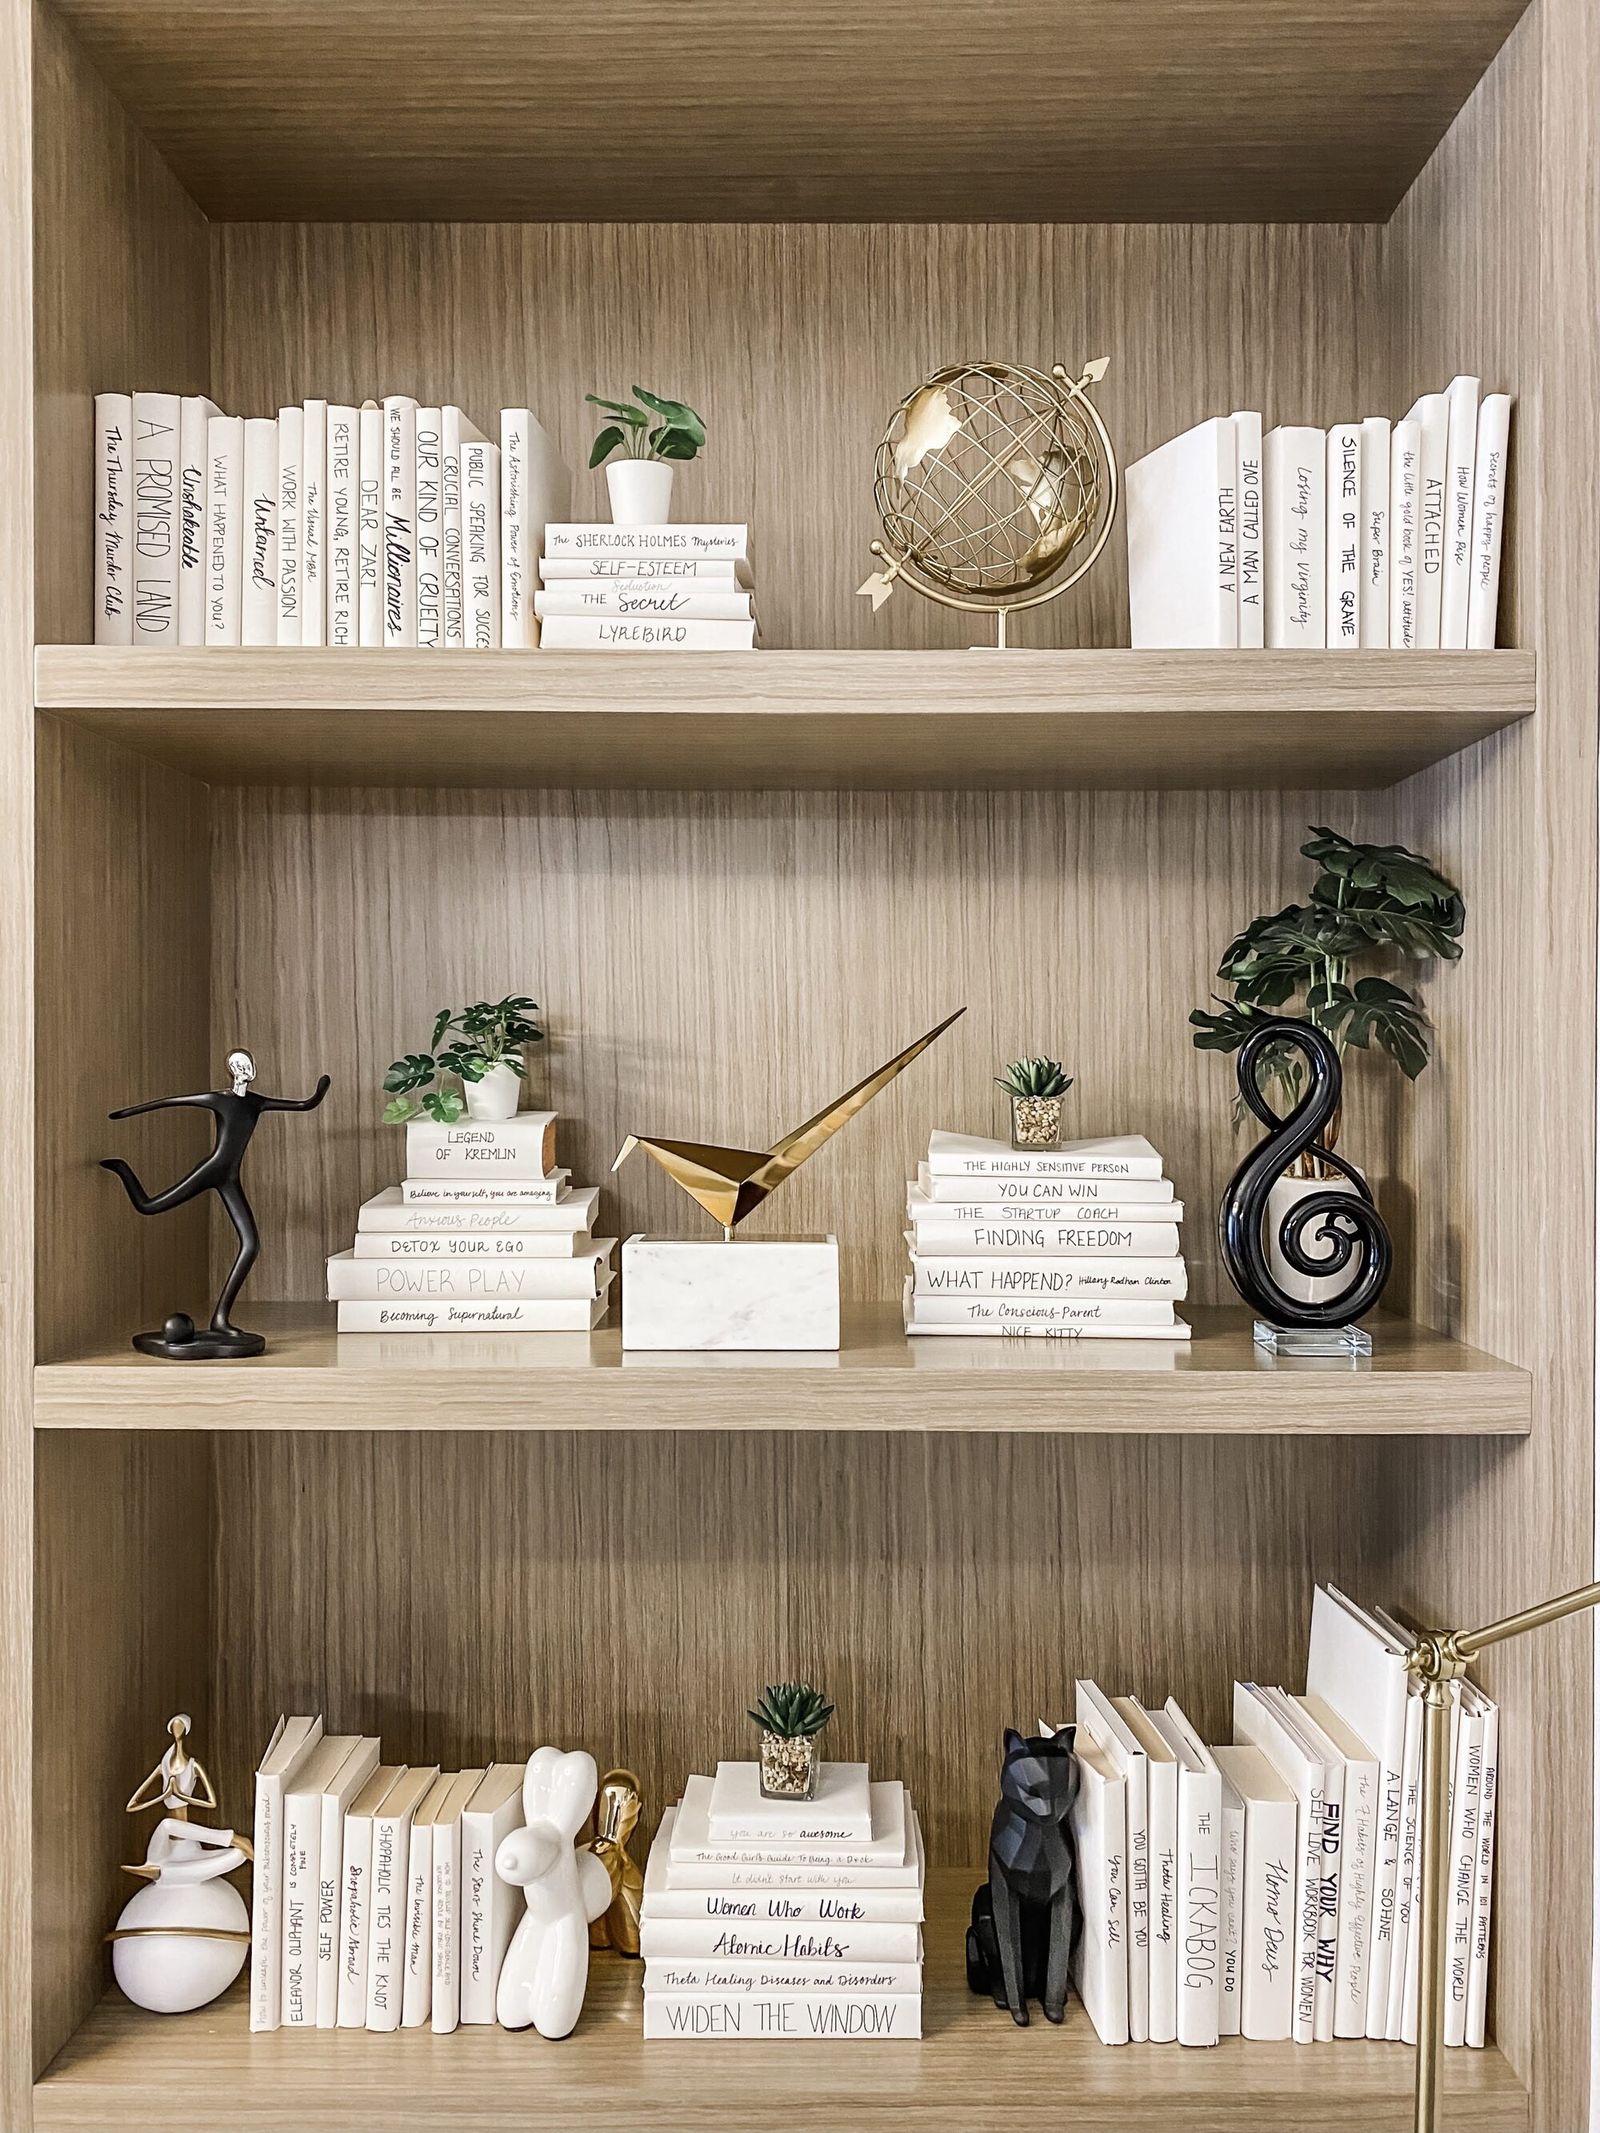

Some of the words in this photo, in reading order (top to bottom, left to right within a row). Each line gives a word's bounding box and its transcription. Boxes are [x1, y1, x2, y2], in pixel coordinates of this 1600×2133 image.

[136, 419, 175, 441] A
[389, 407, 402, 423] WE
[104, 425, 123, 455] The
[332, 423, 350, 479] RETIRE
[389, 426, 401, 461] SHOULD
[417, 430, 440, 470] OUR
[213, 454, 228, 497] WHAT
[390, 465, 401, 483] ALL
[1242, 459, 1259, 486] OVE
[1341, 435, 1358, 499] SILENCE
[98, 455, 124, 526] Thursday
[281, 464, 298, 511] WORK
[391, 487, 402, 502] BE
[417, 480, 439, 523] KIND
[443, 455, 460, 516] CRUCIAL
[135, 458, 174, 558] PROMISED
[359, 479, 379, 531] DEAR
[1218, 487, 1236, 534] EARTH
[1242, 489, 1260, 540] CALLED
[1342, 512, 1356, 529] OF
[211, 503, 227, 572] HAPPENED
[251, 492, 277, 591] Untamed
[281, 518, 297, 552] WITH
[575, 533, 635, 548] SHERLOCK
[638, 534, 687, 548] HOLMES
[1423, 478, 1444, 575] ATTACHED
[104, 530, 124, 582] Murder
[418, 536, 439, 558] OF
[1218, 541, 1236, 576] NEW
[1341, 543, 1356, 574] THE
[334, 547, 351, 604] RETIRE
[360, 543, 378, 589] ZARI
[384, 511, 412, 637] Millionaires
[443, 526, 463, 640] CONVERSATIONS
[589, 559, 698, 578] SELF-ESTEEM
[1242, 550, 1260, 584] MAN
[212, 575, 225, 592] TO
[280, 558, 299, 618] PASSION
[1218, 583, 1236, 593] A
[1242, 593, 1260, 606] A
[104, 585, 124, 621] Club
[135, 579, 173, 633] LAND
[210, 596, 225, 630] YOU?
[418, 572, 440, 649] CRUELTY
[580, 593, 607, 605] THE
[618, 592, 691, 613] Secret
[1339, 590, 1356, 637] GRAVE
[334, 610, 349, 646] RICH
[598, 623, 687, 644] LYREBIRD
[435, 1147, 452, 1161] OF
[464, 1147, 516, 1161] KREMLIN
[447, 1130, 495, 1145] LEGEND
[962, 1160, 987, 1172] THE
[991, 1160, 1031, 1172] HIGHLY
[1035, 1160, 1087, 1173] SENSITIVE
[1091, 1162, 1130, 1174] PERSON
[998, 1183, 1029, 1198] YOU
[1032, 1183, 1063, 1198] CAN
[1068, 1183, 1098, 1198] WIN
[953, 1206, 985, 1220] THE
[1001, 1206, 1061, 1221] STARTUP
[1076, 1206, 1119, 1220] COACH
[391, 1239, 441, 1254] DETOX
[448, 1239, 490, 1254] YOUR
[495, 1240, 524, 1254] EGO
[974, 1228, 1045, 1249] FINDING
[1057, 1228, 1132, 1247] FREEDOM
[376, 1266, 456, 1294] POWER
[467, 1268, 526, 1294] PLAY
[926, 1269, 984, 1289] WHAT
[991, 1270, 1073, 1292] HAPPEND?
[379, 1309, 439, 1327] Becoming
[447, 1305, 524, 1324] Supernatural
[1000, 1325, 1033, 1338] NICE
[1465, 1744, 1483, 1797] WOMEN
[1484, 1766, 1497, 1801] AROUND
[1197, 1811, 1211, 1835] THE
[1309, 1786, 1327, 1826] SELF
[1482, 1809, 1493, 1828] THE
[1132, 1828, 1147, 1851] YOU
[1320, 1801, 1342, 1857] FIND
[1461, 1807, 1478, 1840] WHO
[377, 1824, 394, 1895] SHOPAHOLIC
[472, 1848, 484, 1873] The
[1306, 1831, 1322, 1868] LOVE
[1480, 1837, 1491, 1866] WORLD
[1132, 1856, 1149, 1893] GOTTA
[1456, 1854, 1475, 1907] CHANGE
[1480, 1874, 1489, 1885] IN
[319, 1879, 336, 1924] POWER
[706, 1896, 757, 1917] Women
[768, 1899, 803, 1918] Who
[819, 1898, 866, 1920] Work
[1132, 1900, 1147, 1918] BE
[1302, 1877, 1322, 1944] WORKBOOK
[1318, 1870, 1340, 1919] YOUR
[376, 1904, 392, 1929] TIES
[1454, 1916, 1468, 1945] THE
[318, 1932, 333, 1962] SELF
[376, 1937, 392, 1964] THE
[712, 1931, 783, 1957] Atomic
[783, 1933, 850, 1958] Habits
[1134, 1924, 1149, 1949] YOU
[1300, 1951, 1317, 1974] FOR
[1313, 1936, 1338, 1985] WHY
[289, 1963, 304, 2023] ELEANOR
[373, 1973, 390, 2011] KNOT
[704, 1971, 757, 1992] Healing
[813, 1974, 835, 1986] and
[1451, 1957, 1469, 2003] WORLD
[1298, 1976, 1315, 2025] WOMEN
[665, 2002, 741, 2034] WIDEN
[752, 2002, 798, 2033] THE
[806, 2003, 897, 2035] WINDOW
